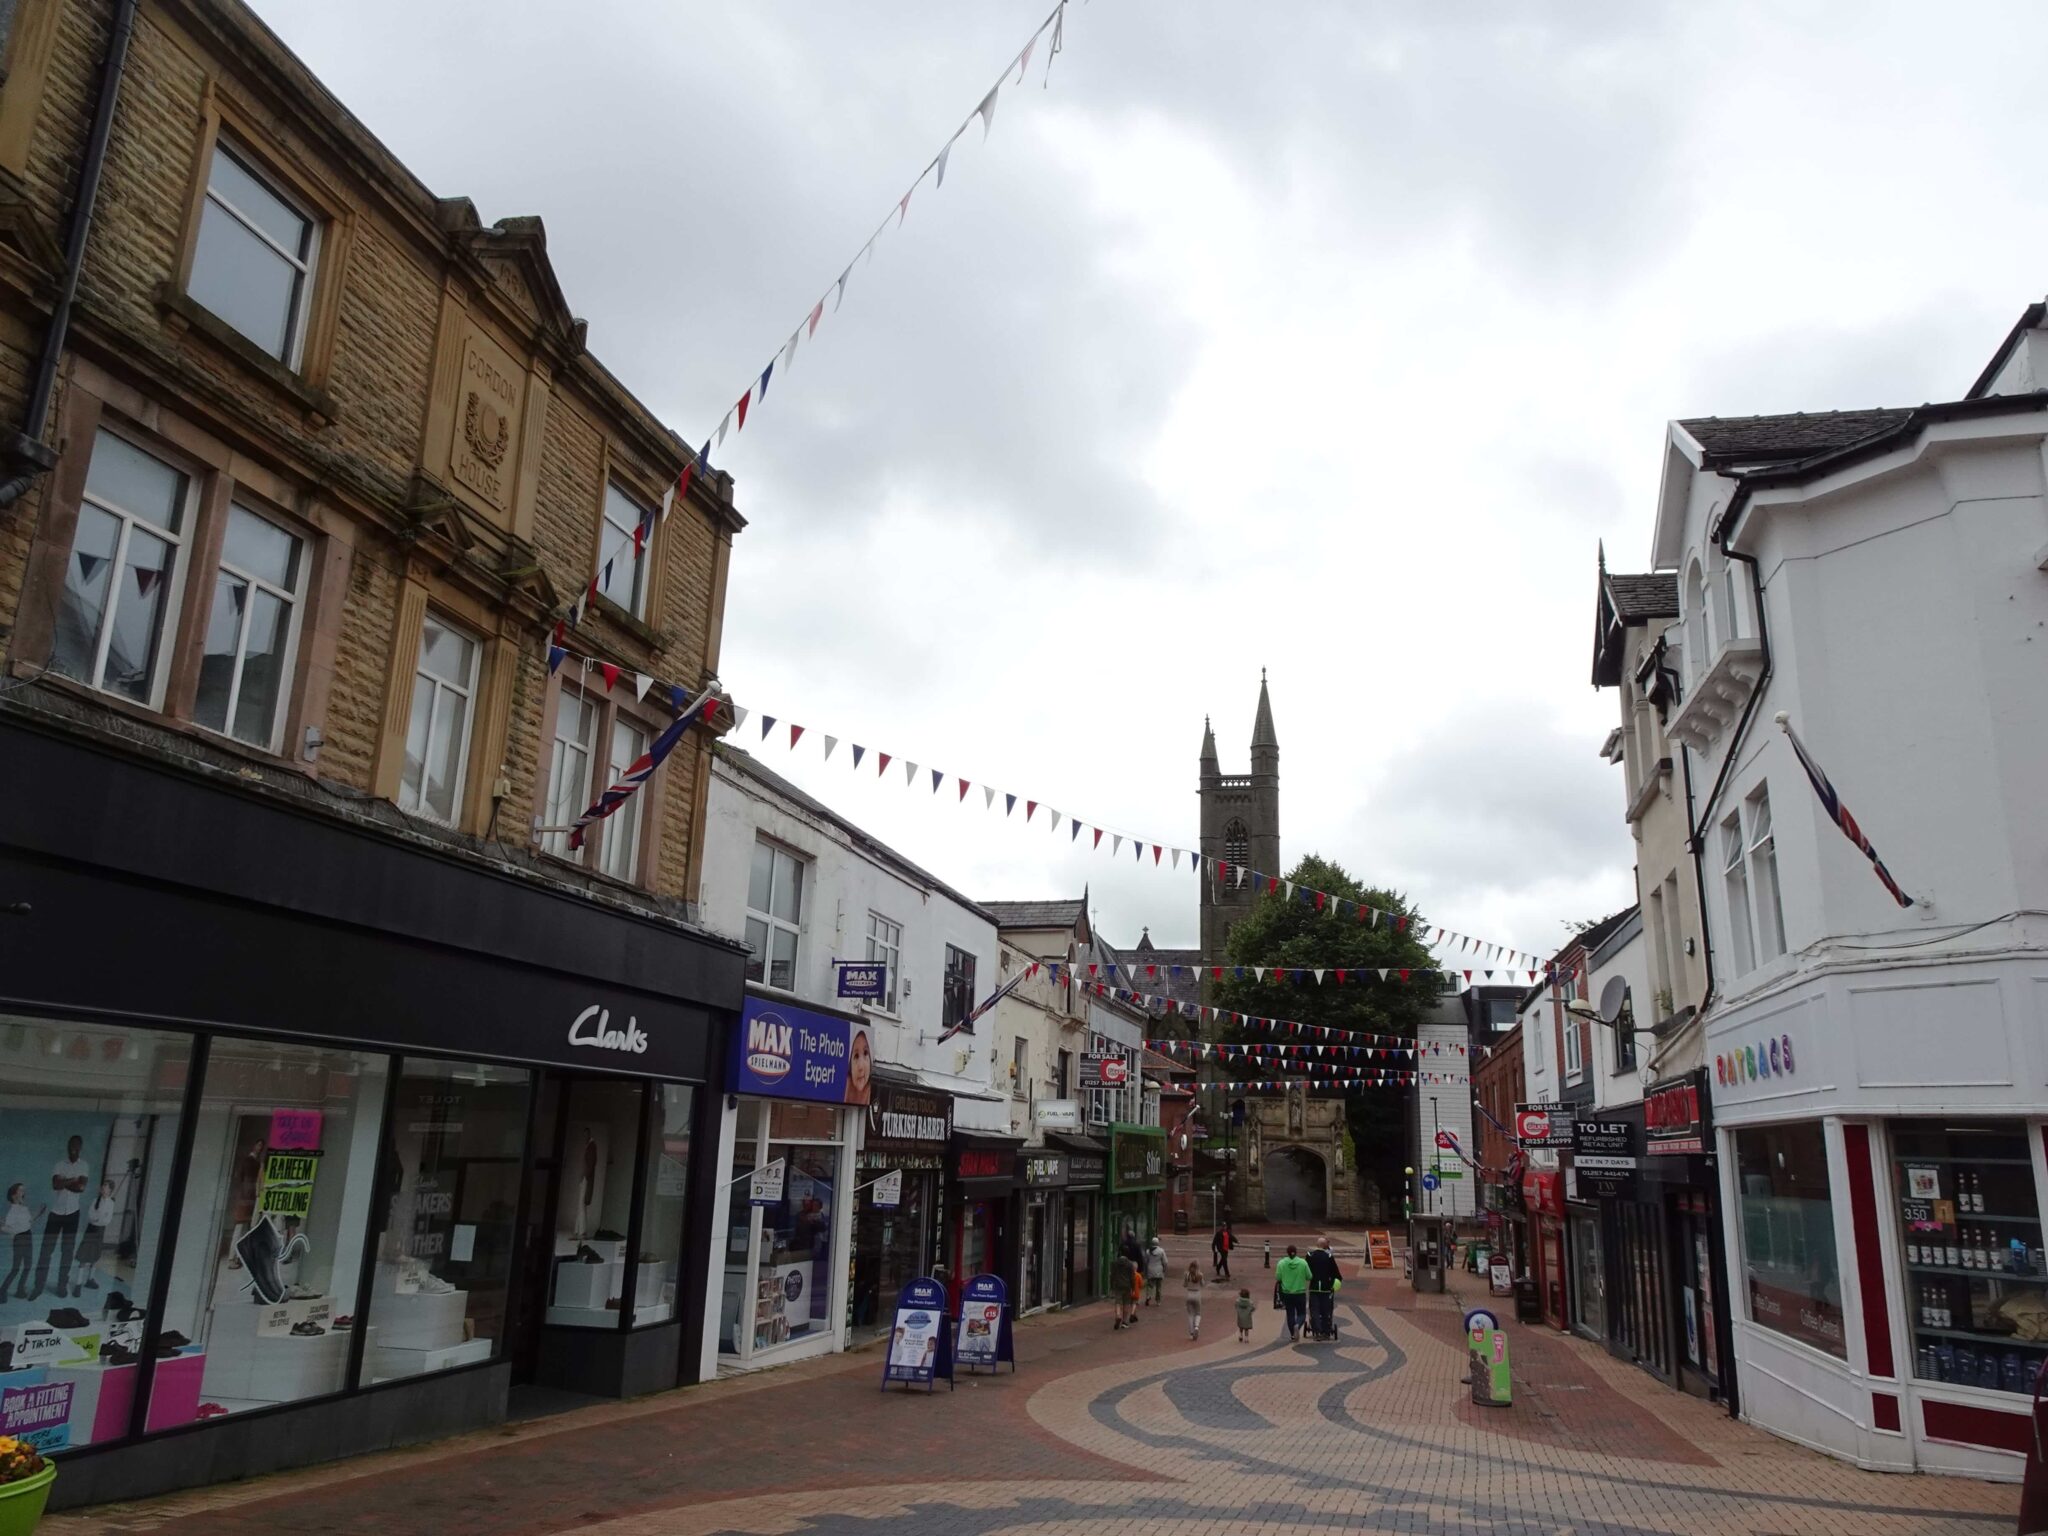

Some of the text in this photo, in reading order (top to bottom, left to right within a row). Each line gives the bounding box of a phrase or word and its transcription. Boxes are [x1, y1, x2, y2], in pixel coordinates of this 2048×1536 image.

[467, 350, 518, 409] GORDON
[458, 453, 502, 500] HOUSE
[846, 970, 878, 980] MAX
[567, 1004, 649, 1054] Clarks
[748, 1018, 793, 1057] MAX
[799, 1028, 845, 1059] The Photo
[750, 1055, 788, 1071] SPIELMANN
[804, 1059, 836, 1088] Expert
[1527, 1103, 1564, 1112] FOR SALE
[882, 1111, 945, 1141] TURKISH BARBER
[1577, 1123, 1597, 1133] TO
[1600, 1123, 1628, 1134] LET
[1579, 1135, 1628, 1143] REFURBISHED
[268, 1157, 313, 1181] RAHEEM
[1033, 1158, 1045, 1176] FUEL
[263, 1190, 309, 1212] STERLING
[1904, 1208, 1928, 1221] 3.50
[31, 1336, 62, 1350] TikTok
[2, 1384, 70, 1414] BOOK A FITTING
[5, 1401, 69, 1429] APPOINTMENT
